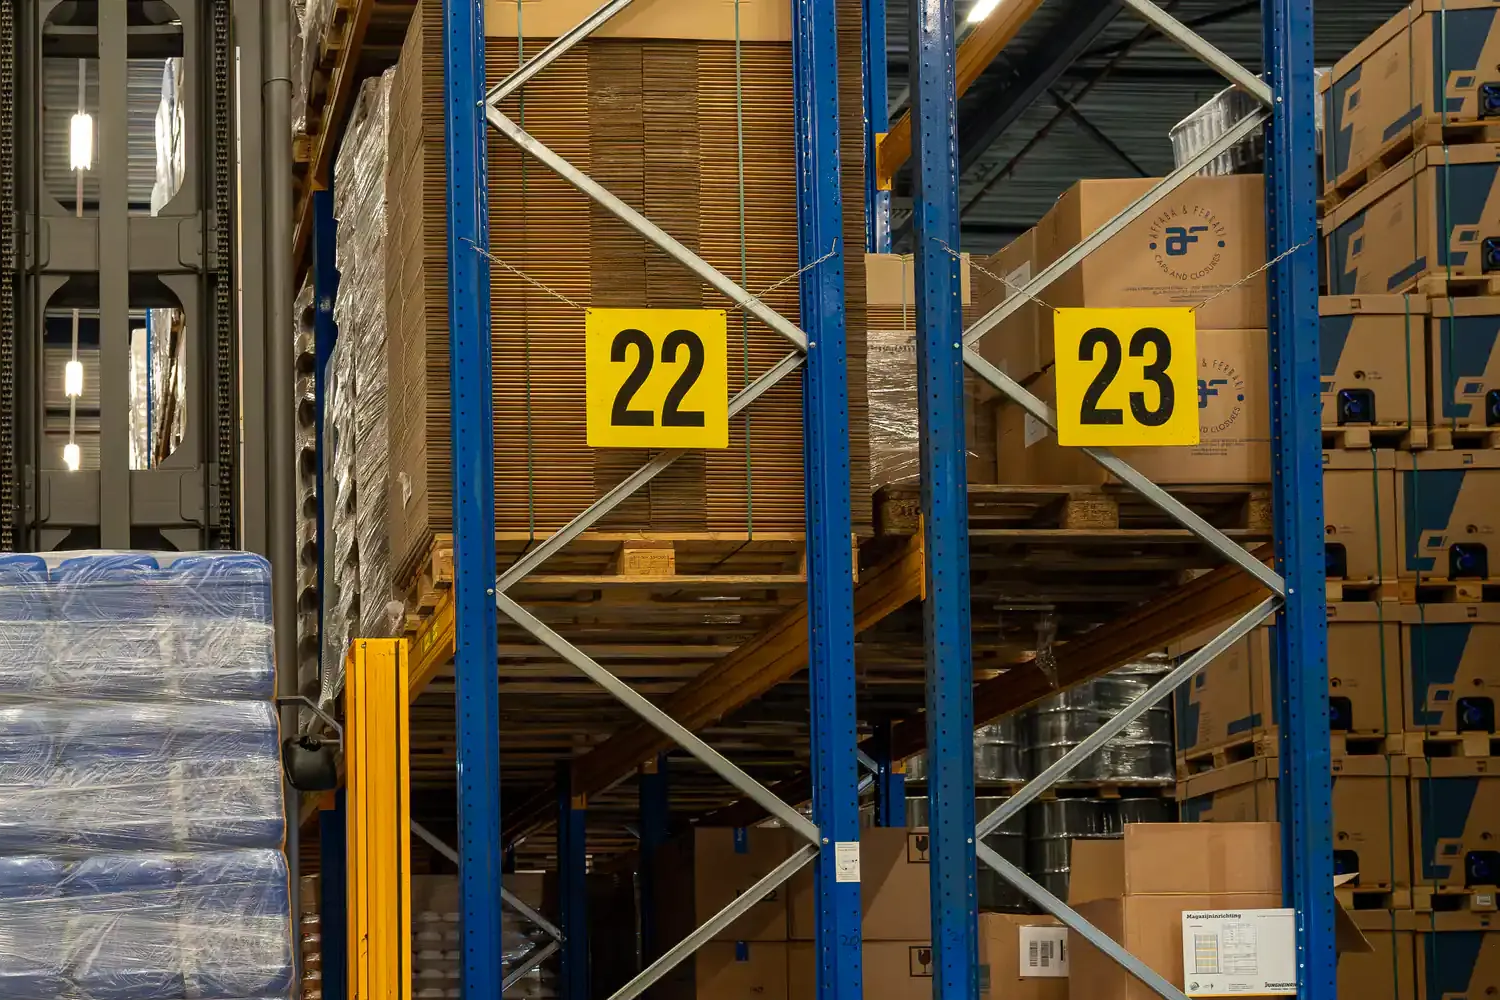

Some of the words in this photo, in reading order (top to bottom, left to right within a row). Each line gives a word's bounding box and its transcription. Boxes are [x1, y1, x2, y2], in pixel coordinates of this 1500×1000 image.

[1193, 205, 1227, 237] FERRARI
[1169, 270, 1188, 281] AND
[1190, 253, 1221, 280] CLOSURES
[610, 329, 706, 428] 22
[1078, 327, 1175, 427] 23
